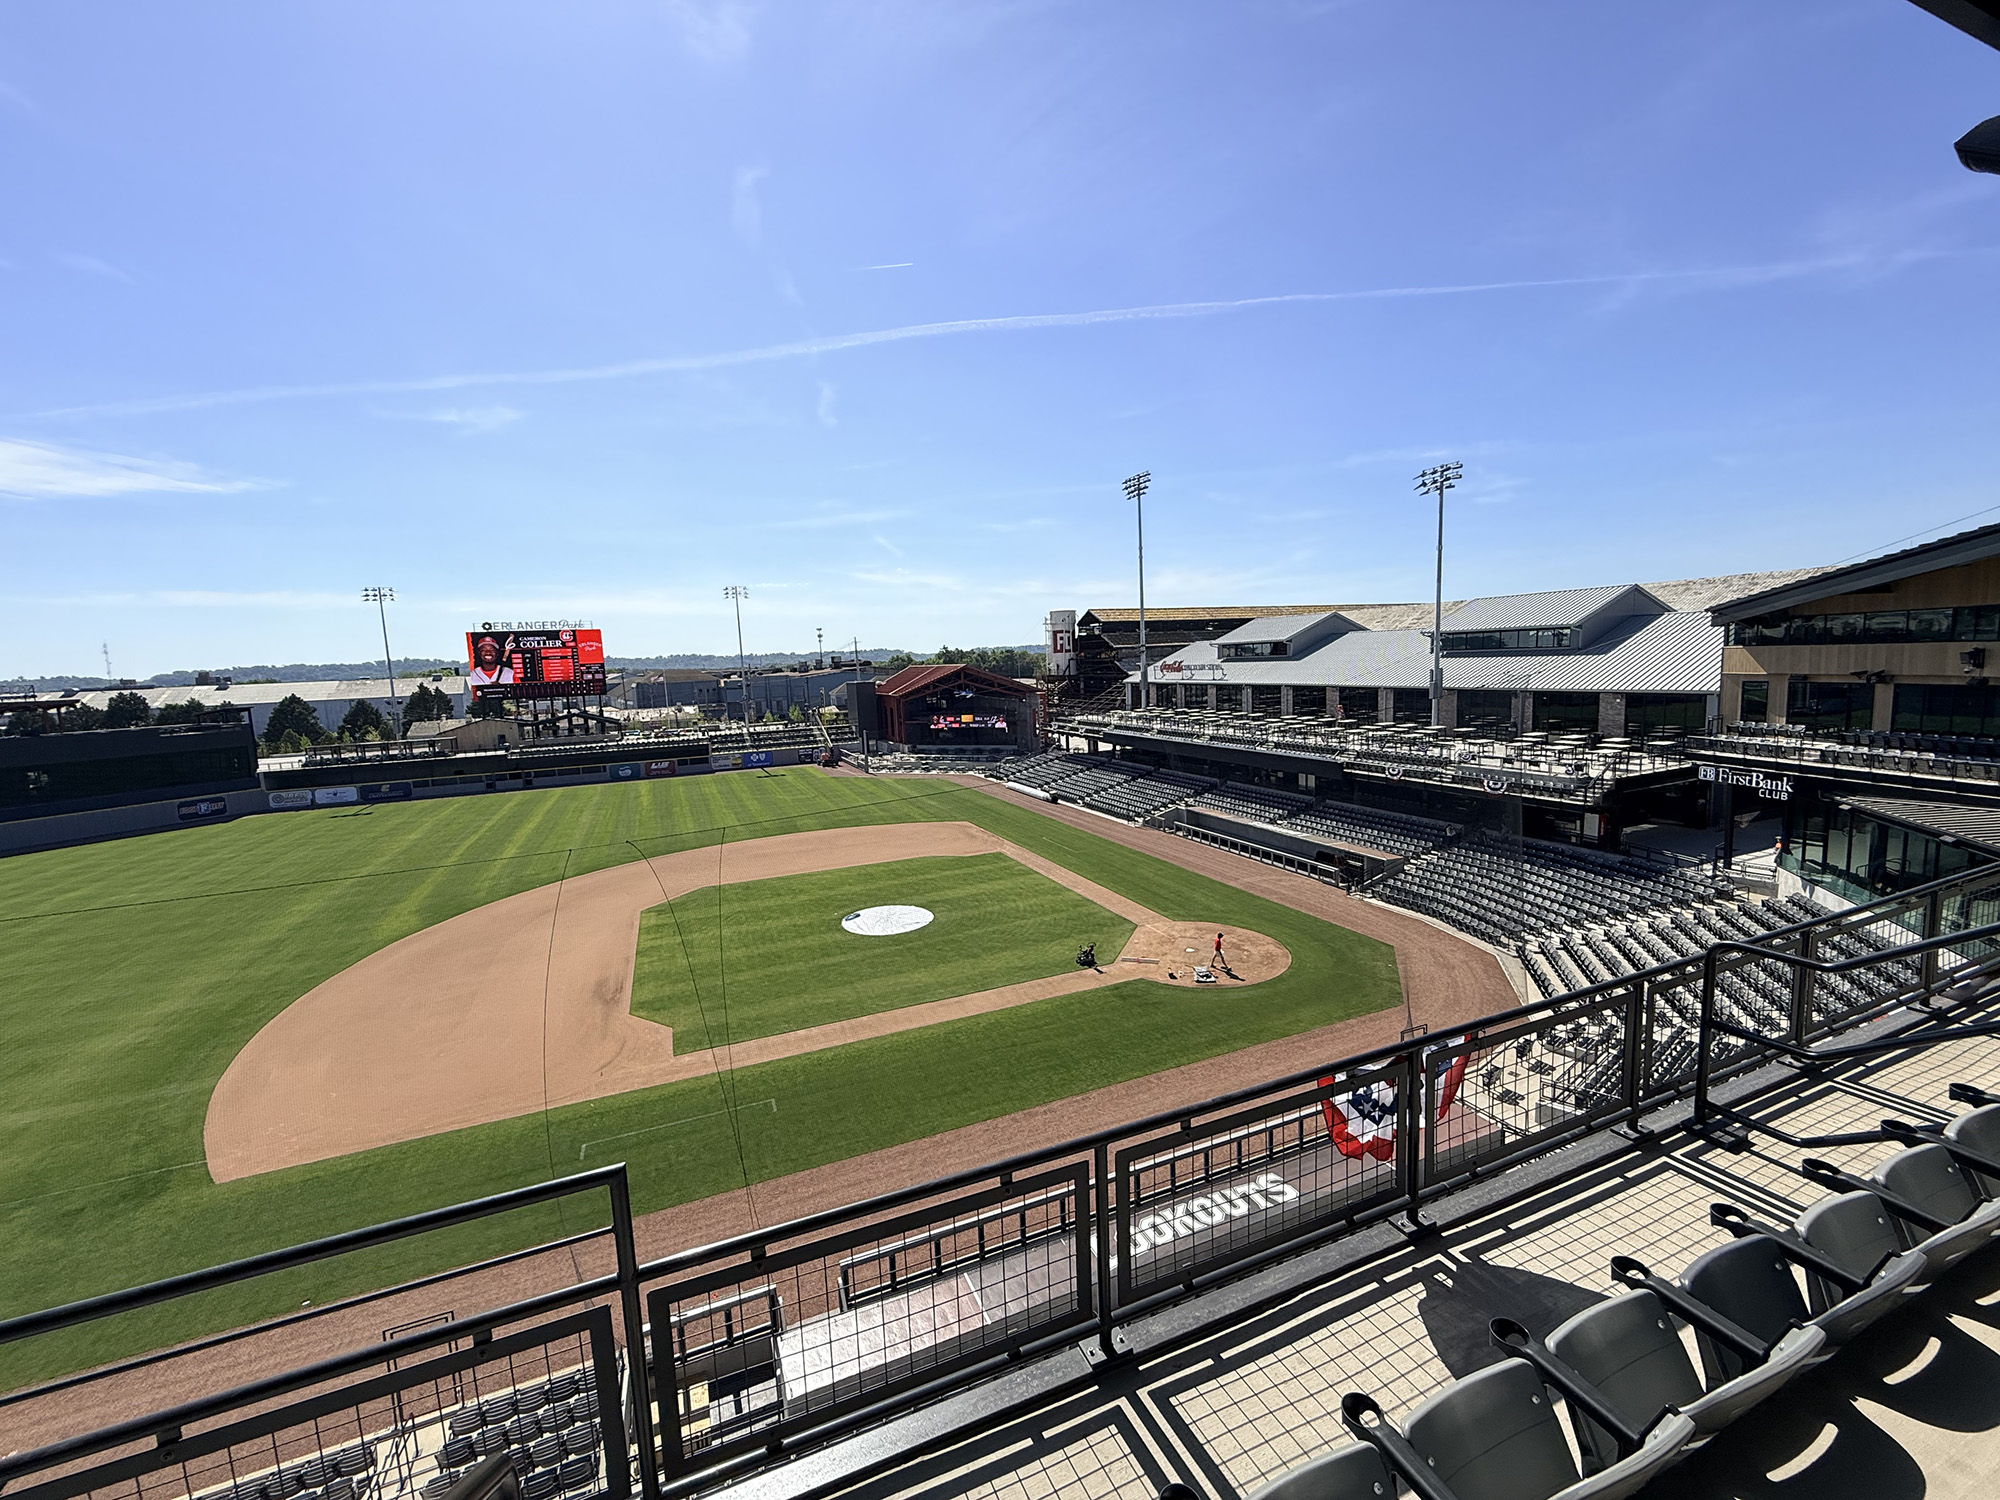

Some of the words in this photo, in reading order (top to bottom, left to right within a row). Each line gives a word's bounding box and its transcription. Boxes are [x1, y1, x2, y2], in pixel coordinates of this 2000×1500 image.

[493, 620, 557, 631] ERLANGER
[559, 619, 585, 629] Park
[520, 640, 563, 649] COLLIER
[1700, 768, 1714, 779] FB
[1717, 768, 1794, 792] FirstBank
[1758, 789, 1788, 801] CLUB
